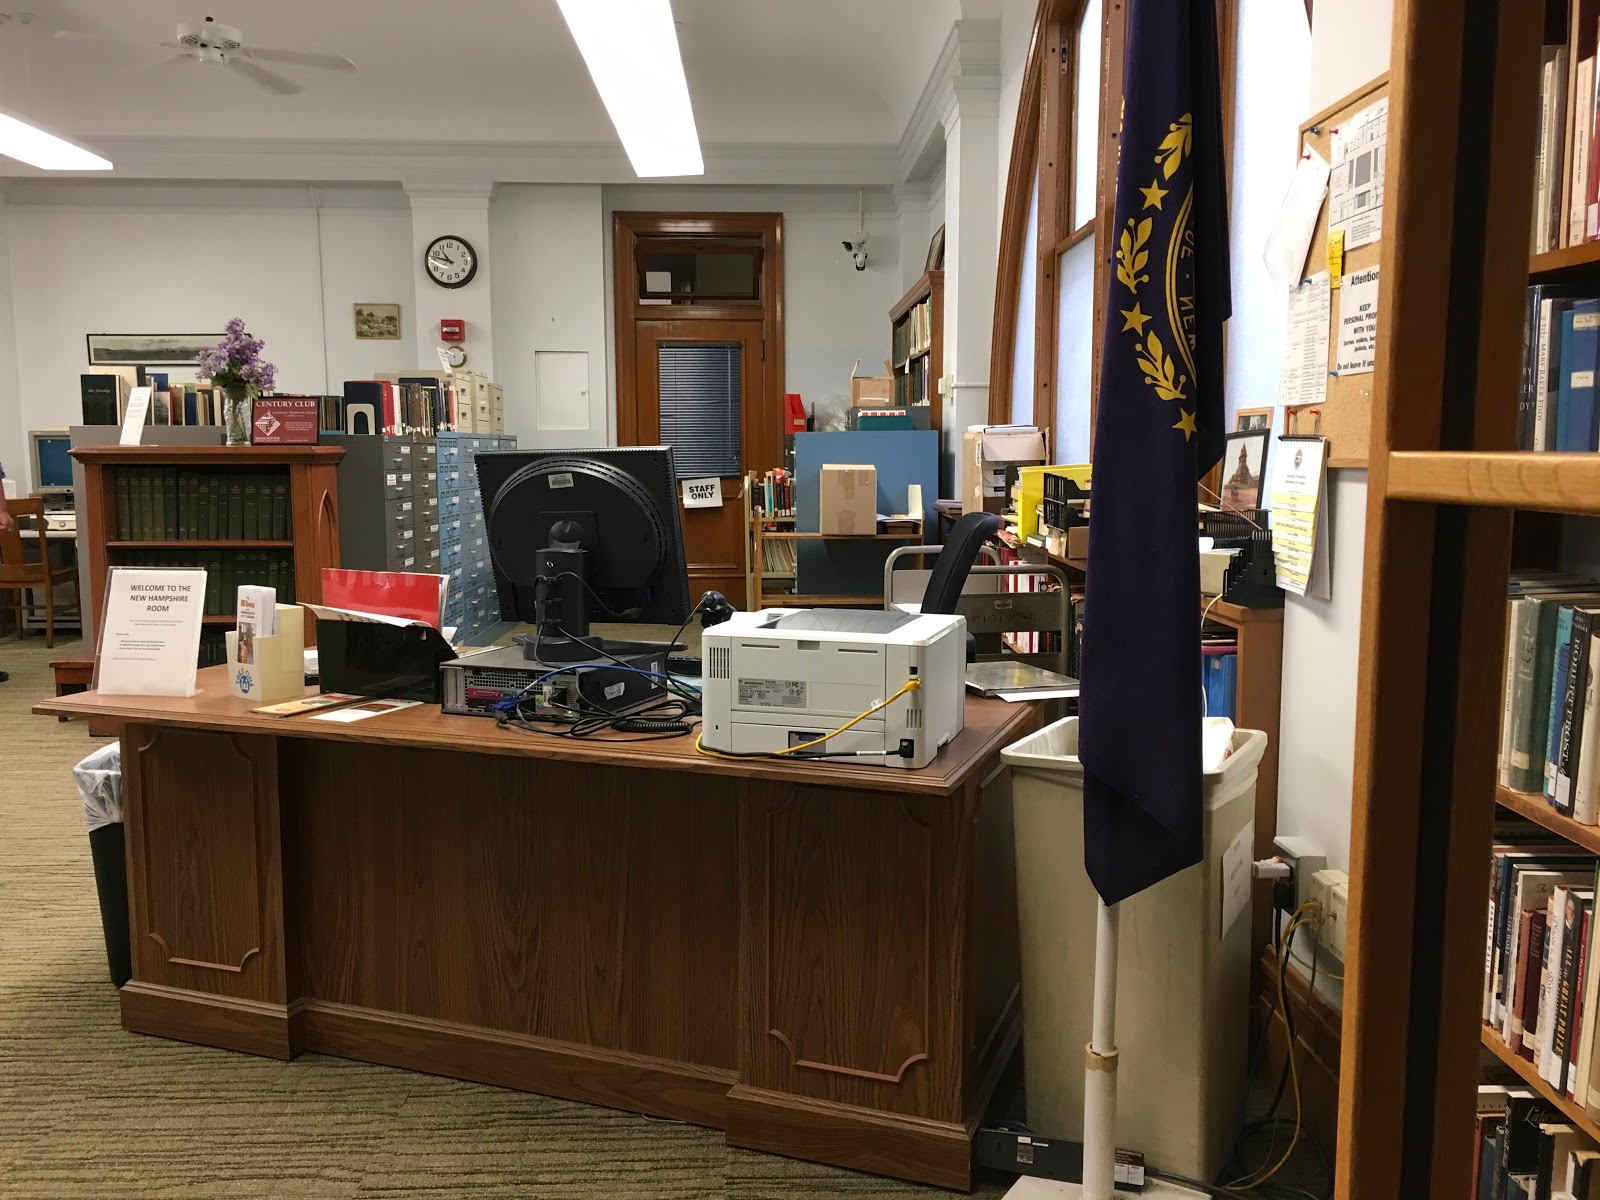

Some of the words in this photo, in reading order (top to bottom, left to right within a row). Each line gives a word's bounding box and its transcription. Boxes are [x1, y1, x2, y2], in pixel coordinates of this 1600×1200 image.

[1359, 303, 1371, 312] KEEP
[1344, 314, 1364, 325] PERSONAL
[1365, 312, 1377, 321] PROP
[1350, 360, 1361, 369] leave
[689, 484, 715, 493] STAFF
[1568, 638, 1581, 707] ROBERT
[1562, 709, 1573, 762] FROST
[1565, 946, 1573, 966] ALL
[1560, 980, 1569, 1017] GREAT
